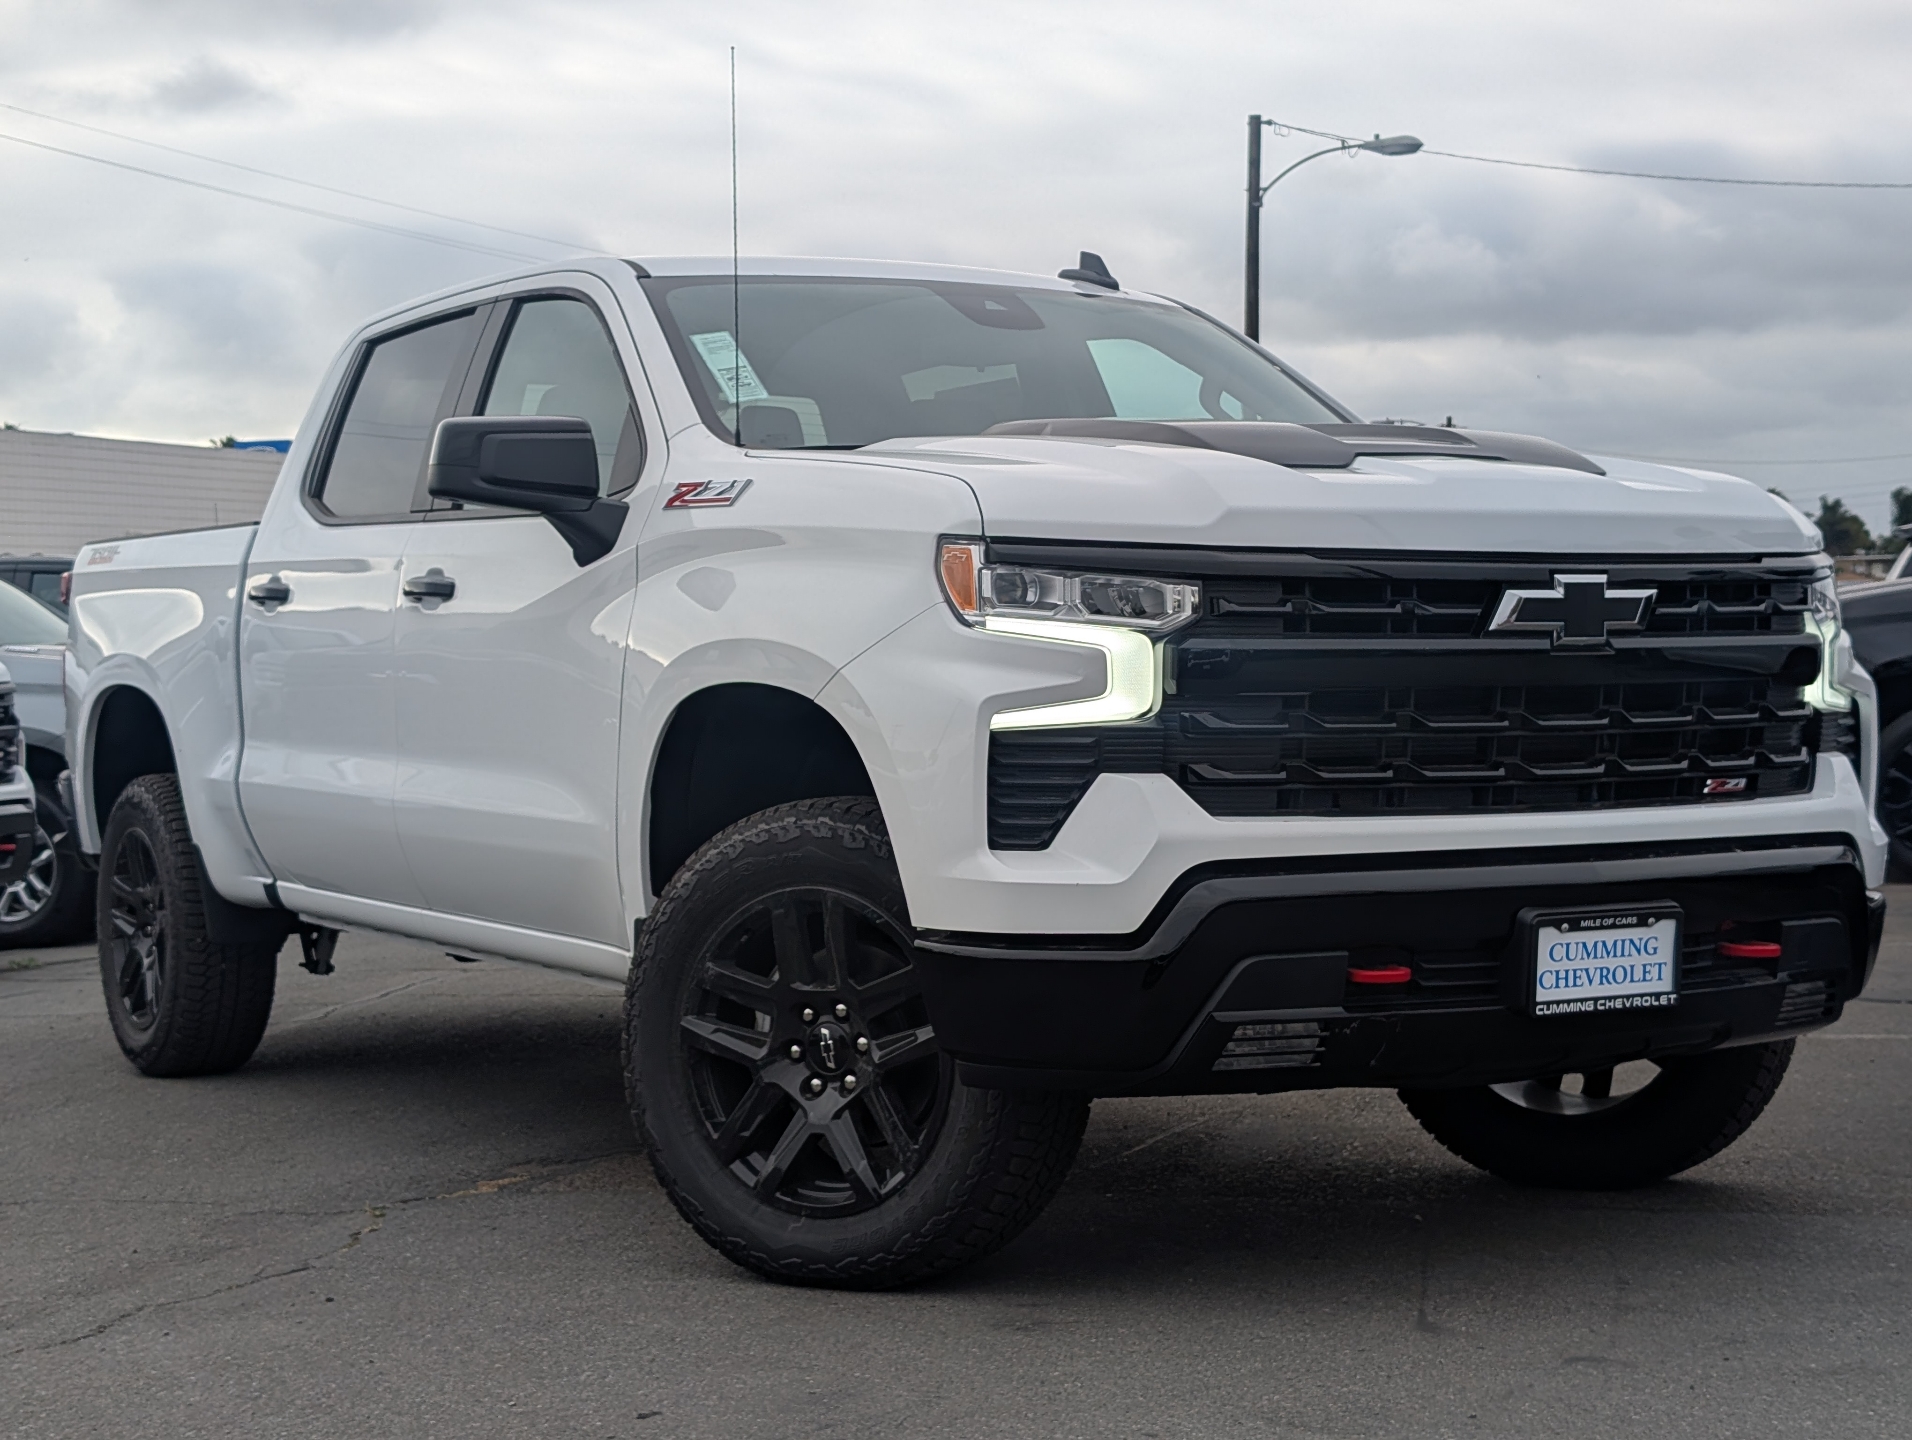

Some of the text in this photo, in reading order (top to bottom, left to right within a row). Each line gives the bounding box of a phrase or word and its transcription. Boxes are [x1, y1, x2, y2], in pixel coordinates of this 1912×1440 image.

[662, 478, 753, 510] Z71
[1580, 917, 1637, 927] MILE OF CARS
[1549, 936, 1659, 963] CUMMING
[1538, 961, 1667, 990] CHEVROLET
[1535, 994, 1677, 1015] CUMMING CHEVROLET
